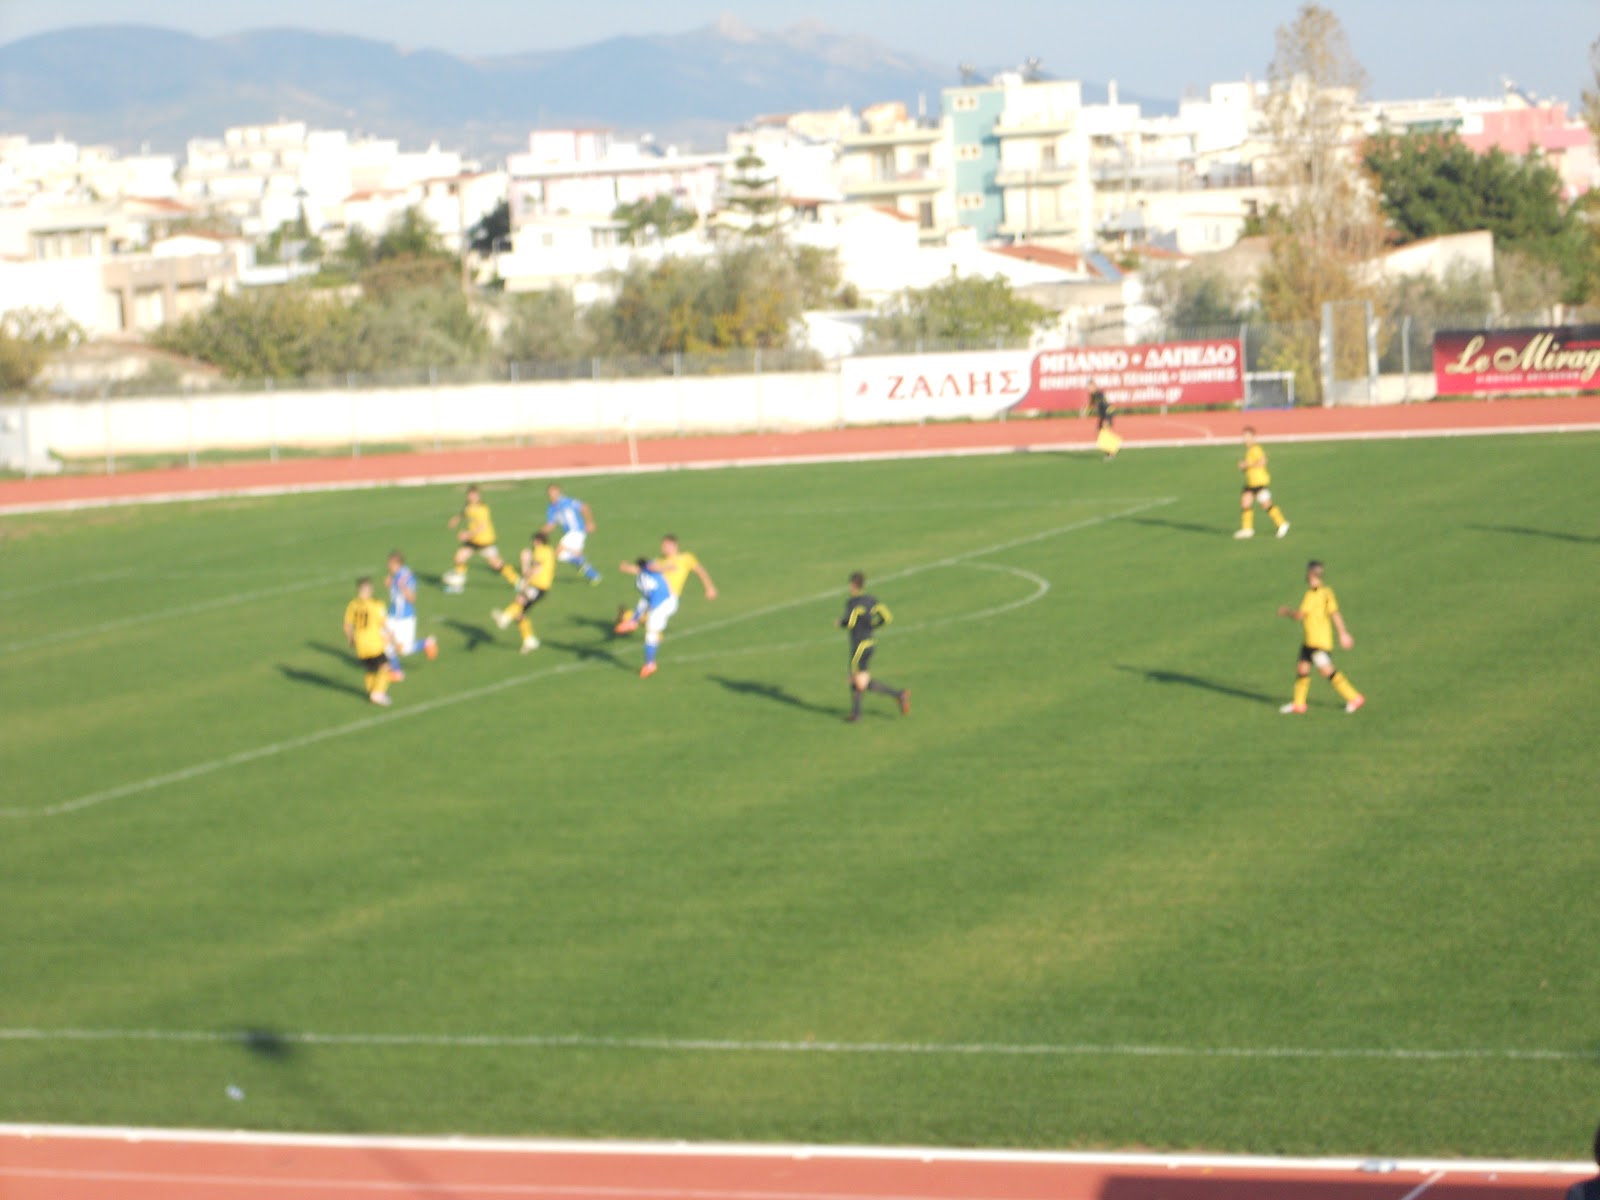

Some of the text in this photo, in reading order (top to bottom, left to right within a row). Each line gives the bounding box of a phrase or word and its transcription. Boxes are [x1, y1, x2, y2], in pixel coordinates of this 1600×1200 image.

[1039, 344, 1237, 373] ΜΠΑΝΙΟ ΔΑΠΕΔΟ
[1445, 335, 1490, 374] Le
[887, 369, 1021, 400] ΖΑΛΗΣ
